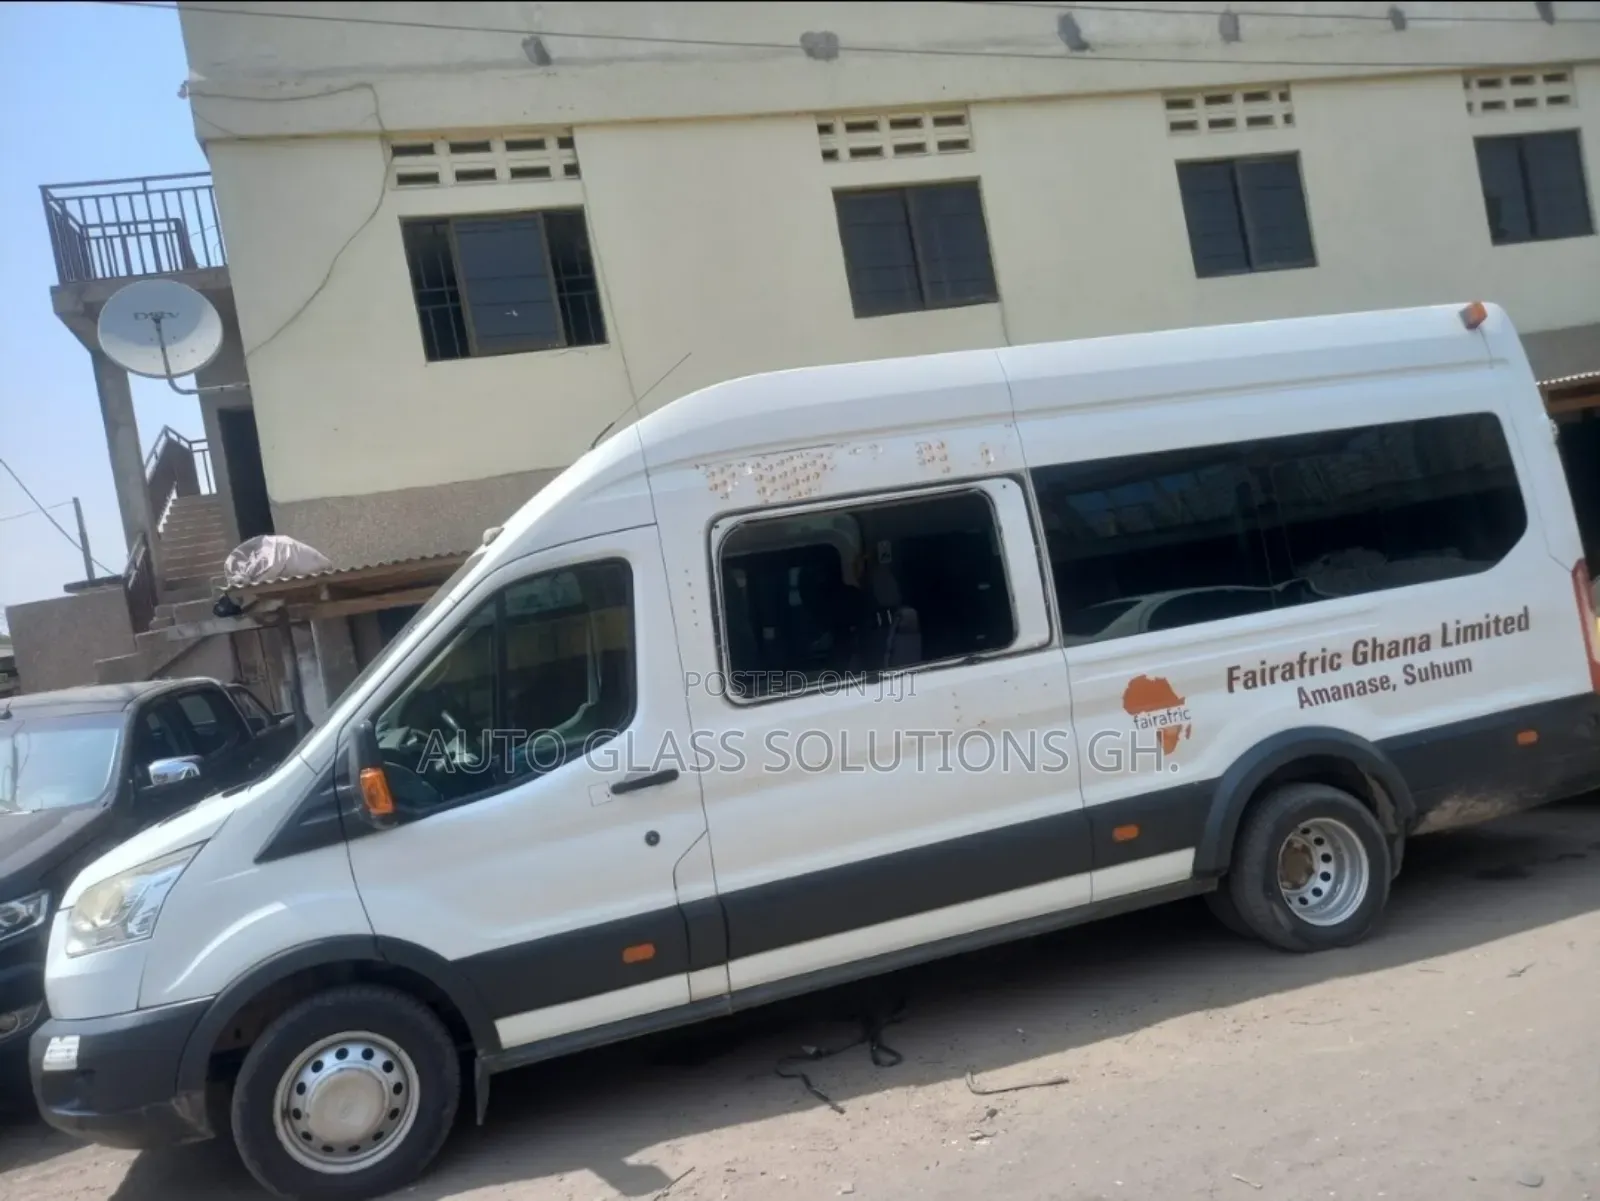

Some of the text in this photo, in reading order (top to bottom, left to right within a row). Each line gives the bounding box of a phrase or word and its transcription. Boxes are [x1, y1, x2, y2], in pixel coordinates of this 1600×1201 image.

[1226, 605, 1530, 693] Fairafric Ghana Limited
[1297, 657, 1473, 709] Amanase, Suhum
[1133, 708, 1192, 730] fairafric
